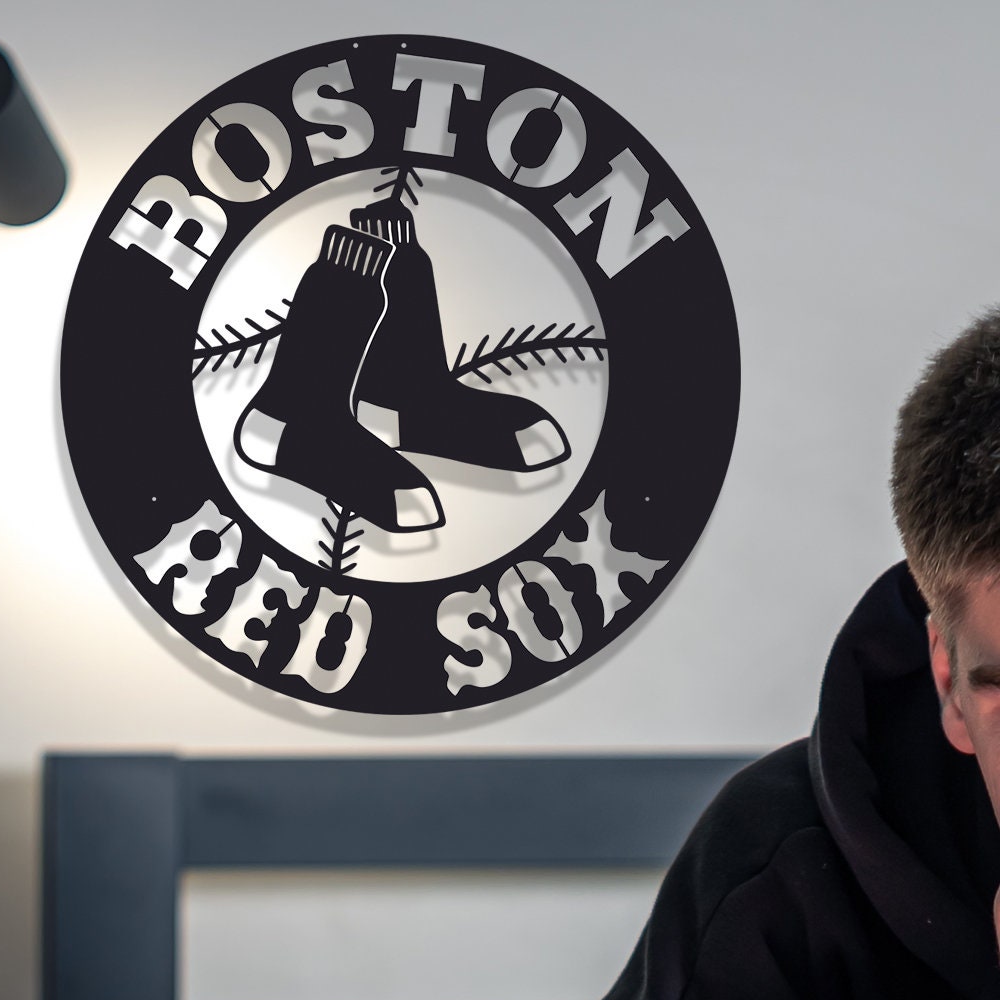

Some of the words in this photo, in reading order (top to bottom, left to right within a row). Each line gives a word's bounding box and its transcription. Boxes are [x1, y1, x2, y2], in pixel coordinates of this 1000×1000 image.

[109, 53, 691, 290] BOSTON
[133, 499, 373, 693] RED
[436, 488, 670, 696] SOX
